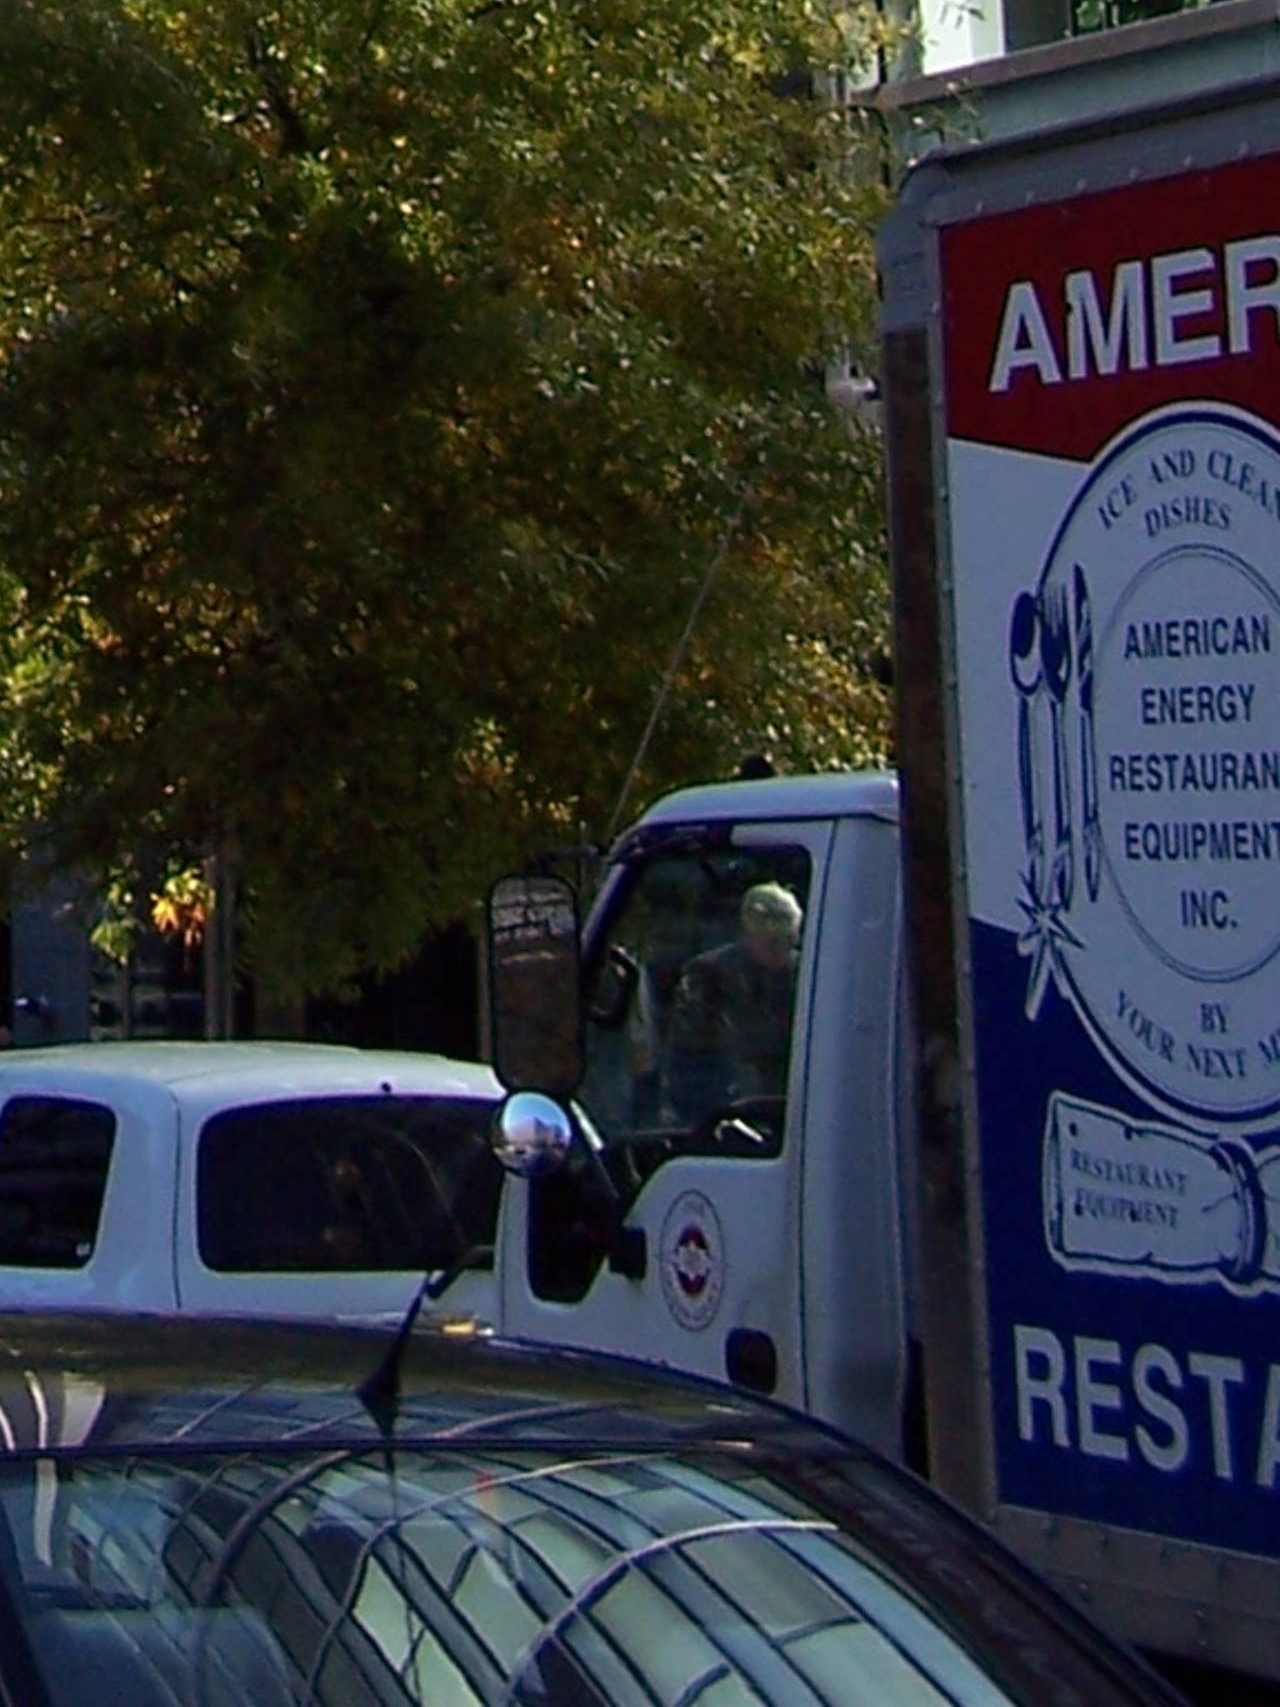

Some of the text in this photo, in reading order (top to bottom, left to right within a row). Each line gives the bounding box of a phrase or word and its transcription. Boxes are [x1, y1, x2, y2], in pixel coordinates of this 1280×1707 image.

[988, 235, 1280, 393] AMER
[1097, 473, 1138, 530] ICE
[1149, 448, 1195, 484] AND
[1143, 494, 1232, 538] DISHES
[1124, 614, 1271, 659] AMERICAN
[1141, 683, 1255, 726] ENERGY
[1180, 889, 1239, 930] INC.
[1117, 989, 1175, 1063] YOUR
[1186, 1041, 1247, 1078] NEXT
[1201, 1002, 1230, 1034] BY
[1070, 1147, 1187, 1197] RESTAURANT
[1074, 1186, 1179, 1229] EQUIPMENT
